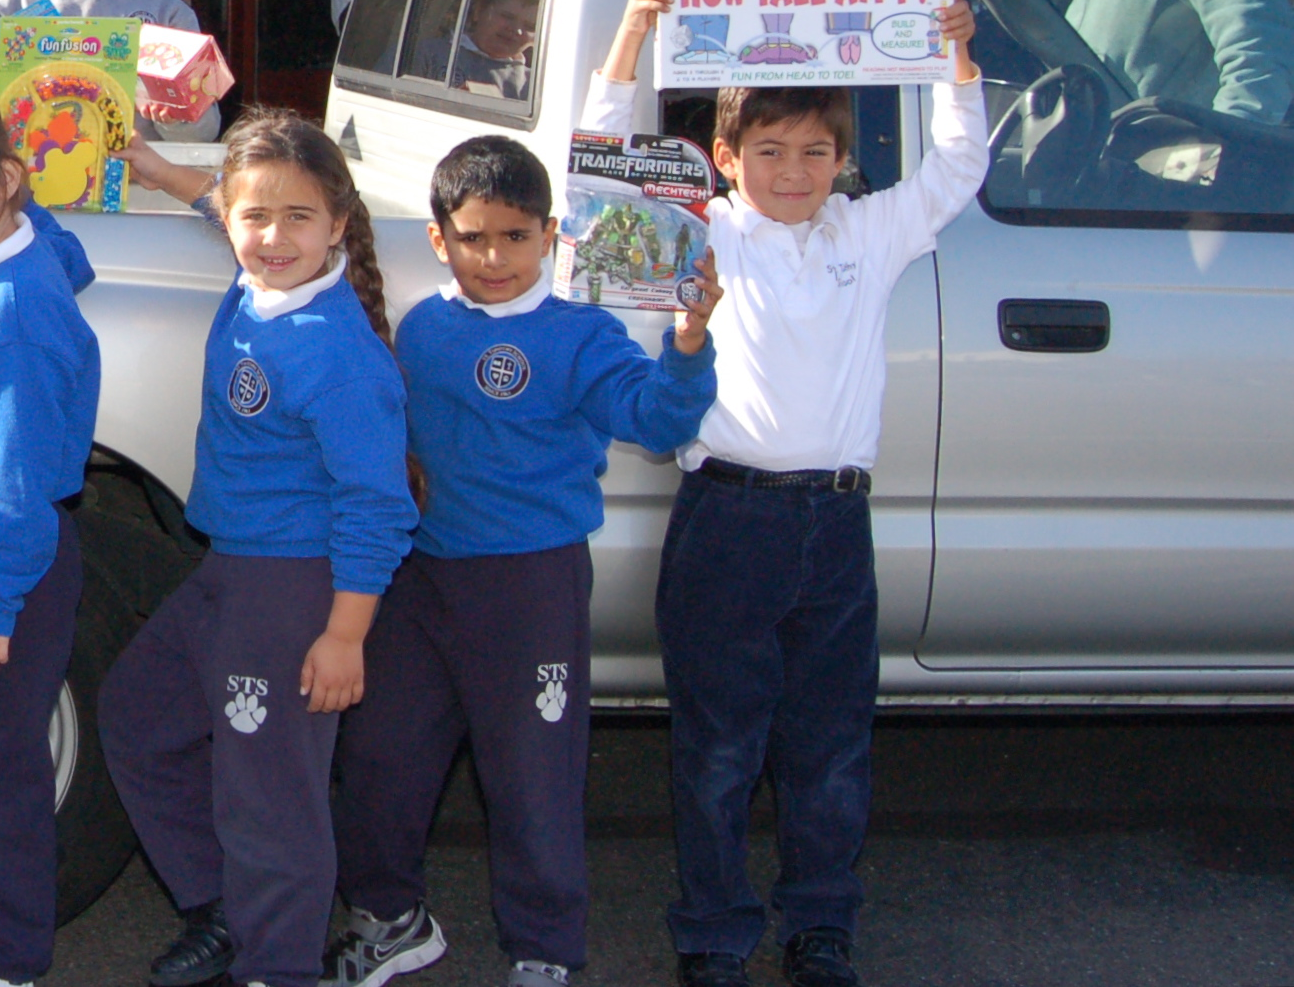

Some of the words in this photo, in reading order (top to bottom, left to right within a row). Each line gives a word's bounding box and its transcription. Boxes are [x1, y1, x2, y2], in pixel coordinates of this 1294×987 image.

[891, 20, 916, 29] BUILD
[894, 30, 913, 38] AND
[731, 72, 752, 81] FUN
[755, 71, 783, 81] FROM
[786, 71, 815, 80] HEAD
[818, 70, 830, 80] TO
[571, 153, 704, 178] TRANSFORMERS
[643, 183, 707, 200] MECHTECH
[537, 662, 568, 682] STS
[226, 674, 269, 696] STS
